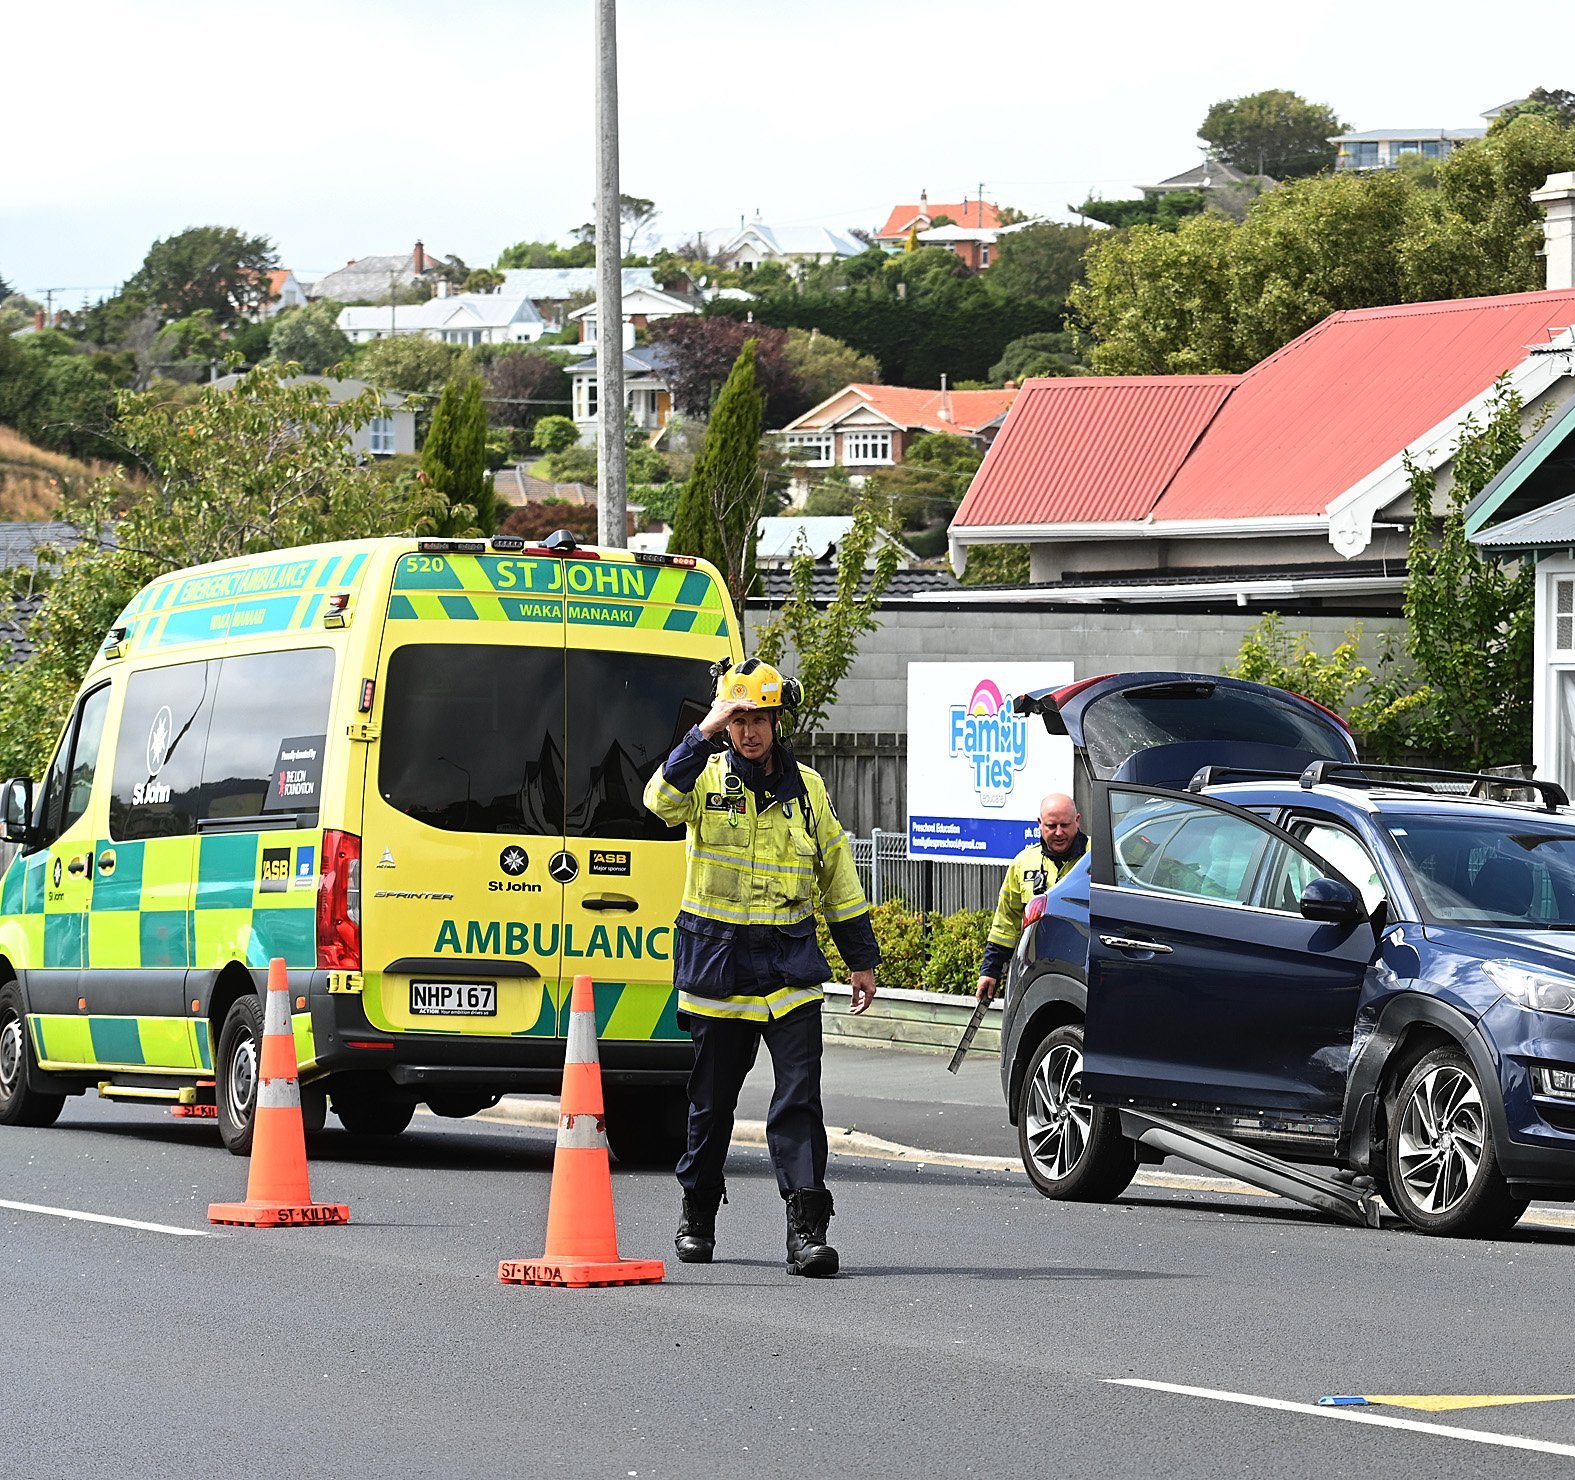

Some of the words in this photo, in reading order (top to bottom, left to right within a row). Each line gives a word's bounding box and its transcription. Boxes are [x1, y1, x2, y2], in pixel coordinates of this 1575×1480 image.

[406, 557, 444, 573] 520
[180, 572, 240, 602] EMERGENCY
[239, 562, 310, 592] AMBULANCE
[497, 561, 538, 588] ST
[549, 559, 645, 596] JOHN
[519, 603, 561, 618] WAKA
[569, 606, 633, 622] MANAAKI
[951, 699, 1026, 765] Family
[286, 770, 294, 783] THE
[972, 754, 1013, 789] Ties
[133, 782, 145, 806] St
[144, 782, 171, 804] John
[284, 782, 315, 796] FOUNDATION
[912, 821, 936, 833] Preschool
[936, 822, 960, 834] Education
[593, 853, 627, 864] ASB
[263, 860, 289, 880] ASB
[374, 890, 455, 901] SPRINTER
[488, 881, 504, 892] St
[506, 881, 542, 892] John
[414, 986, 492, 1008] NHP167
